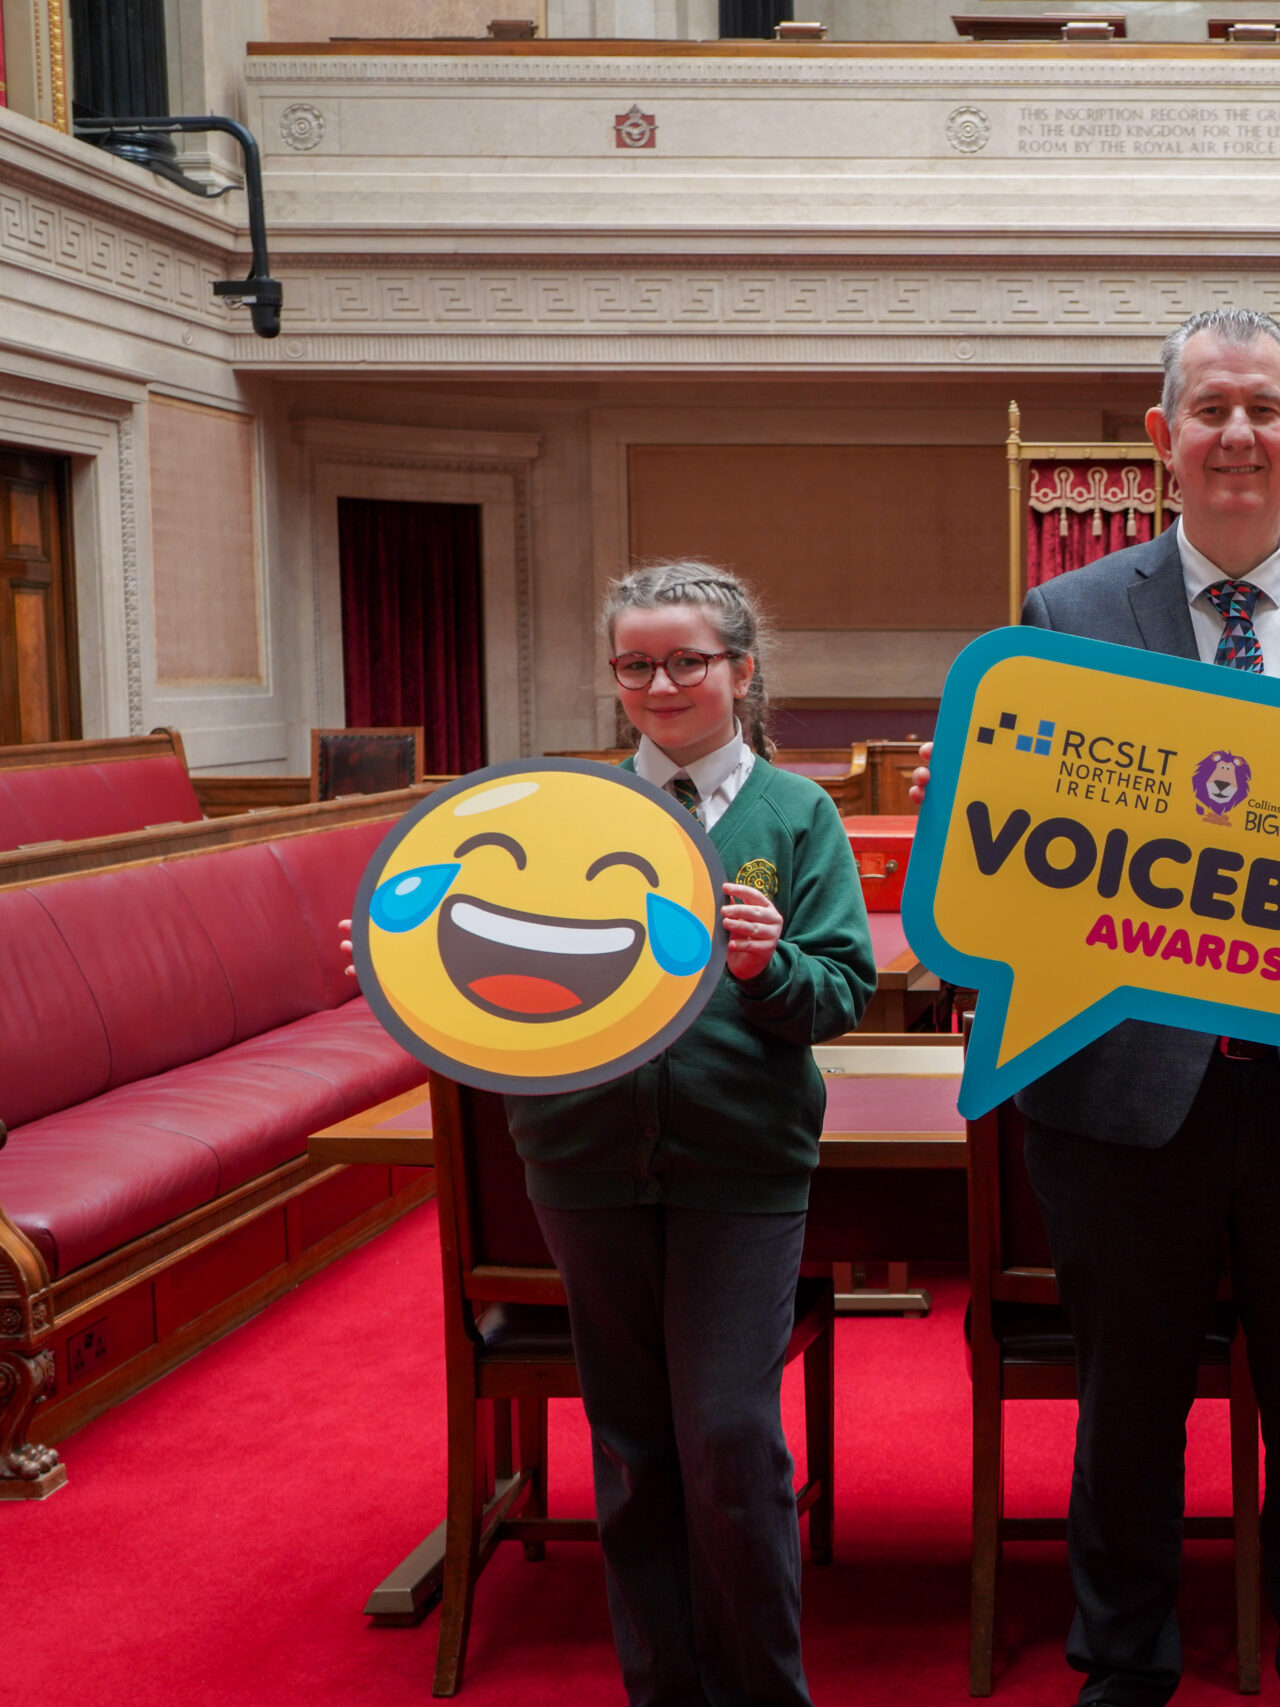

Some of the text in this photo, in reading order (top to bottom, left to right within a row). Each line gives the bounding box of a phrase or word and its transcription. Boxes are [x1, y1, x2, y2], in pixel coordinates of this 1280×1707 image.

[1018, 108, 1049, 121] THIS
[1054, 108, 1144, 122] INSCRIPTION
[1150, 108, 1219, 122] RECORDS
[1224, 108, 1251, 122] THE
[1017, 124, 1033, 137] IN
[1039, 124, 1065, 137] THE
[1069, 124, 1122, 138] UNITED
[1126, 125, 1197, 138] KINGDOM
[1202, 125, 1232, 138] FOR
[1236, 125, 1261, 138] THE
[1017, 140, 1067, 153] ROOM
[1074, 140, 1092, 153] BY
[1100, 140, 1127, 154] THE
[1132, 140, 1184, 154] ROYAL
[1190, 140, 1217, 154] AIR
[1222, 140, 1275, 154] FORCE
[1062, 729, 1178, 776] RCSLT
[1059, 760, 1172, 796] NORTHERN
[1056, 778, 1169, 814] IRELAND
[1245, 811, 1280, 836] BIG
